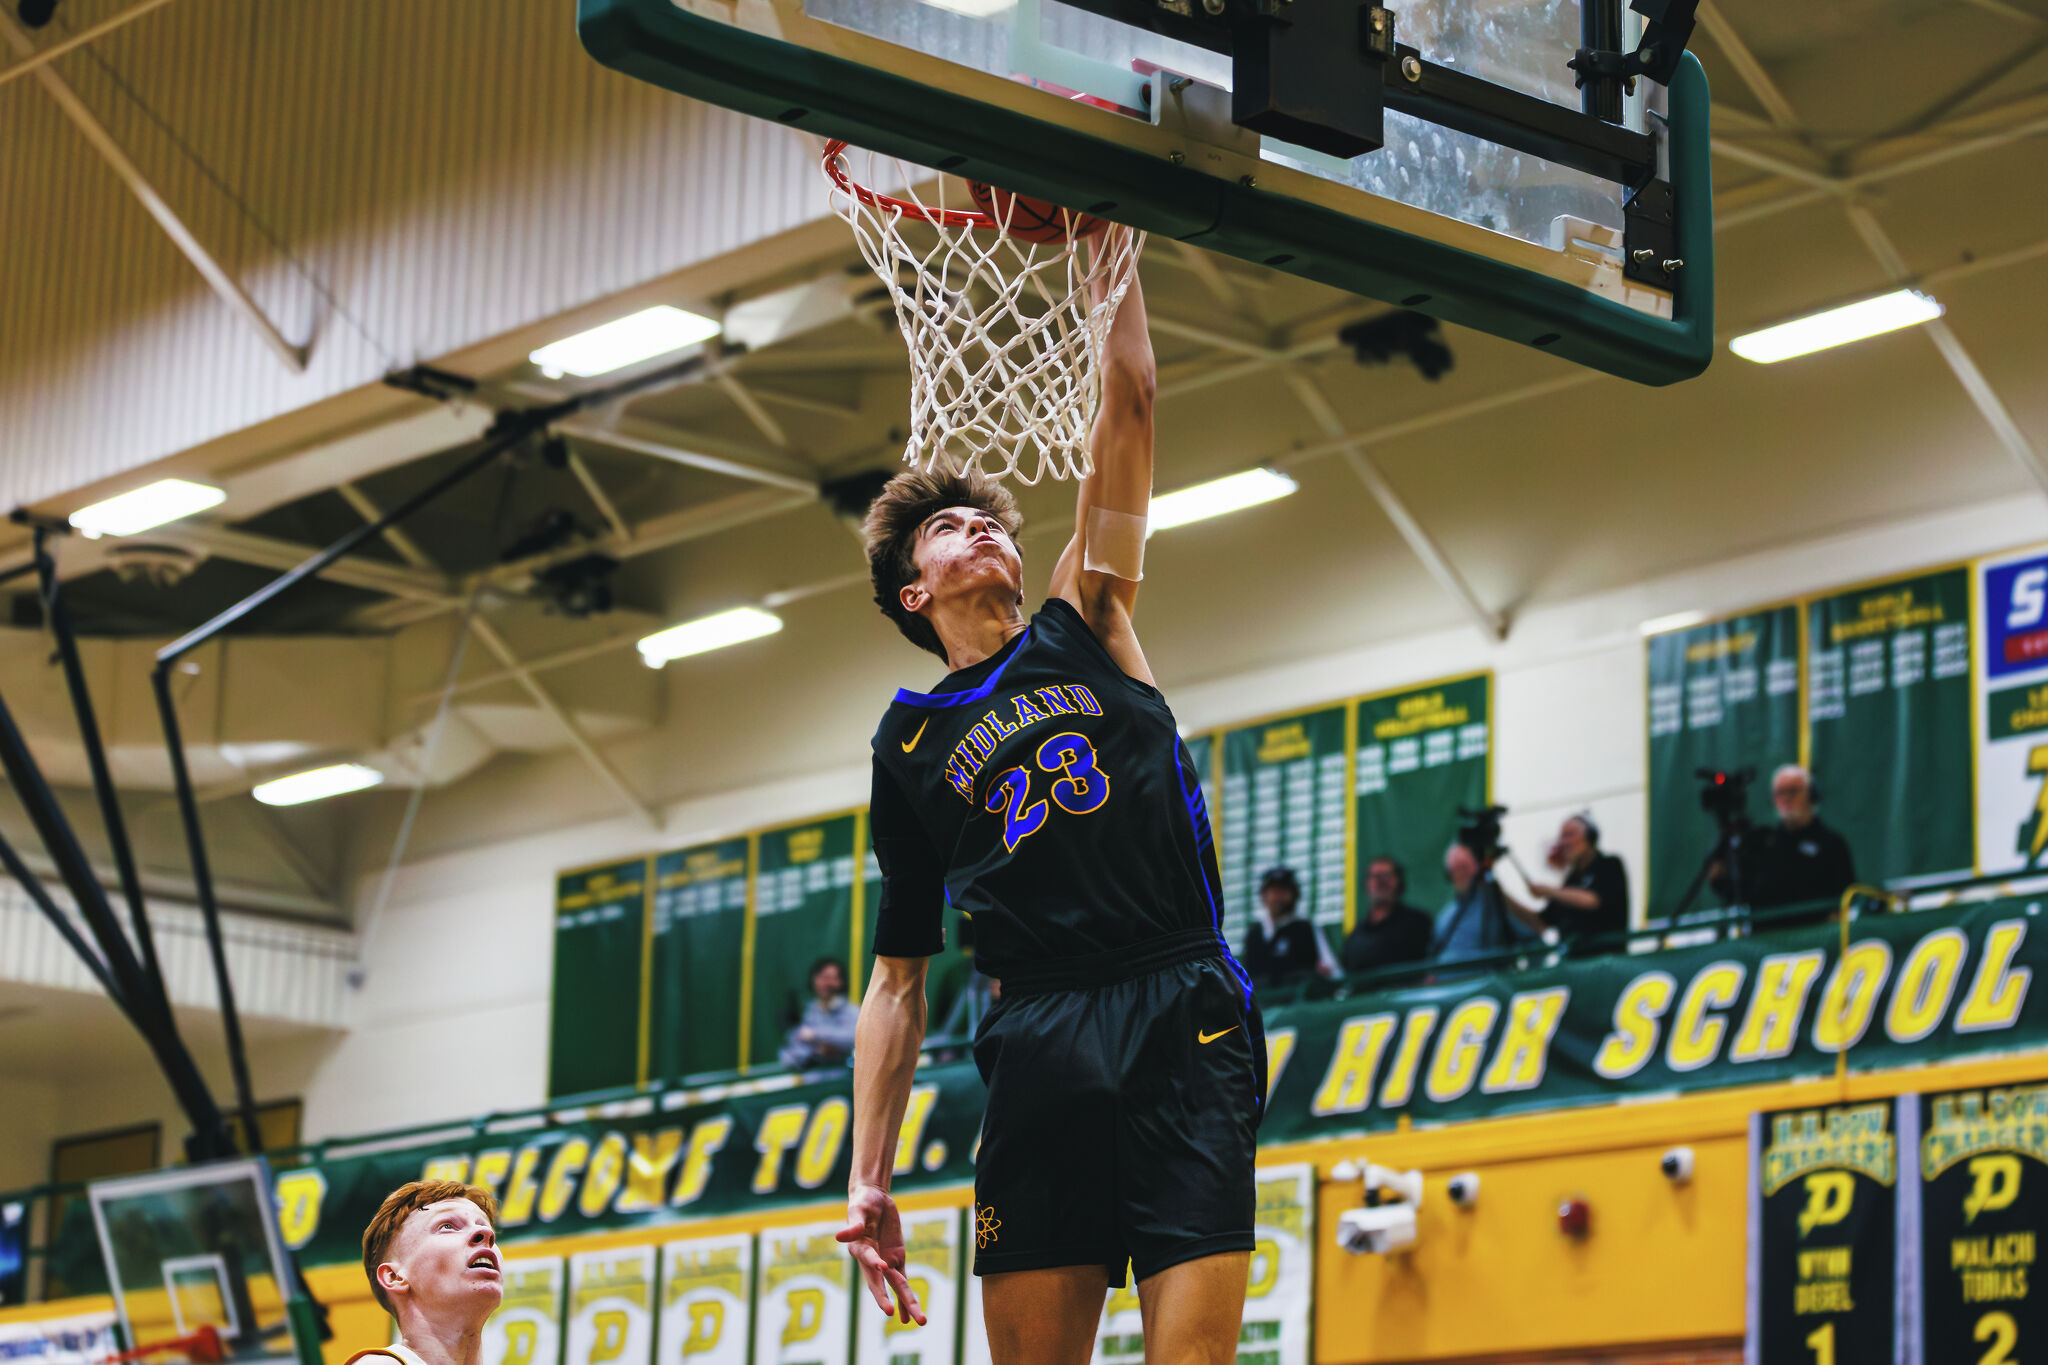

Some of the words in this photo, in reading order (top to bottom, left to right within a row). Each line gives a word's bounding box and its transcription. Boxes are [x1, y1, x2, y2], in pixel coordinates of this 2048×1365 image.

[945, 684, 1104, 804] MIDLAND
[985, 731, 1111, 854] 23
[1311, 987, 1571, 1117] HIGH
[1594, 918, 2032, 1081] SCHOOL
[751, 1096, 851, 1196] TO
[1973, 1309, 2019, 1365] 2
